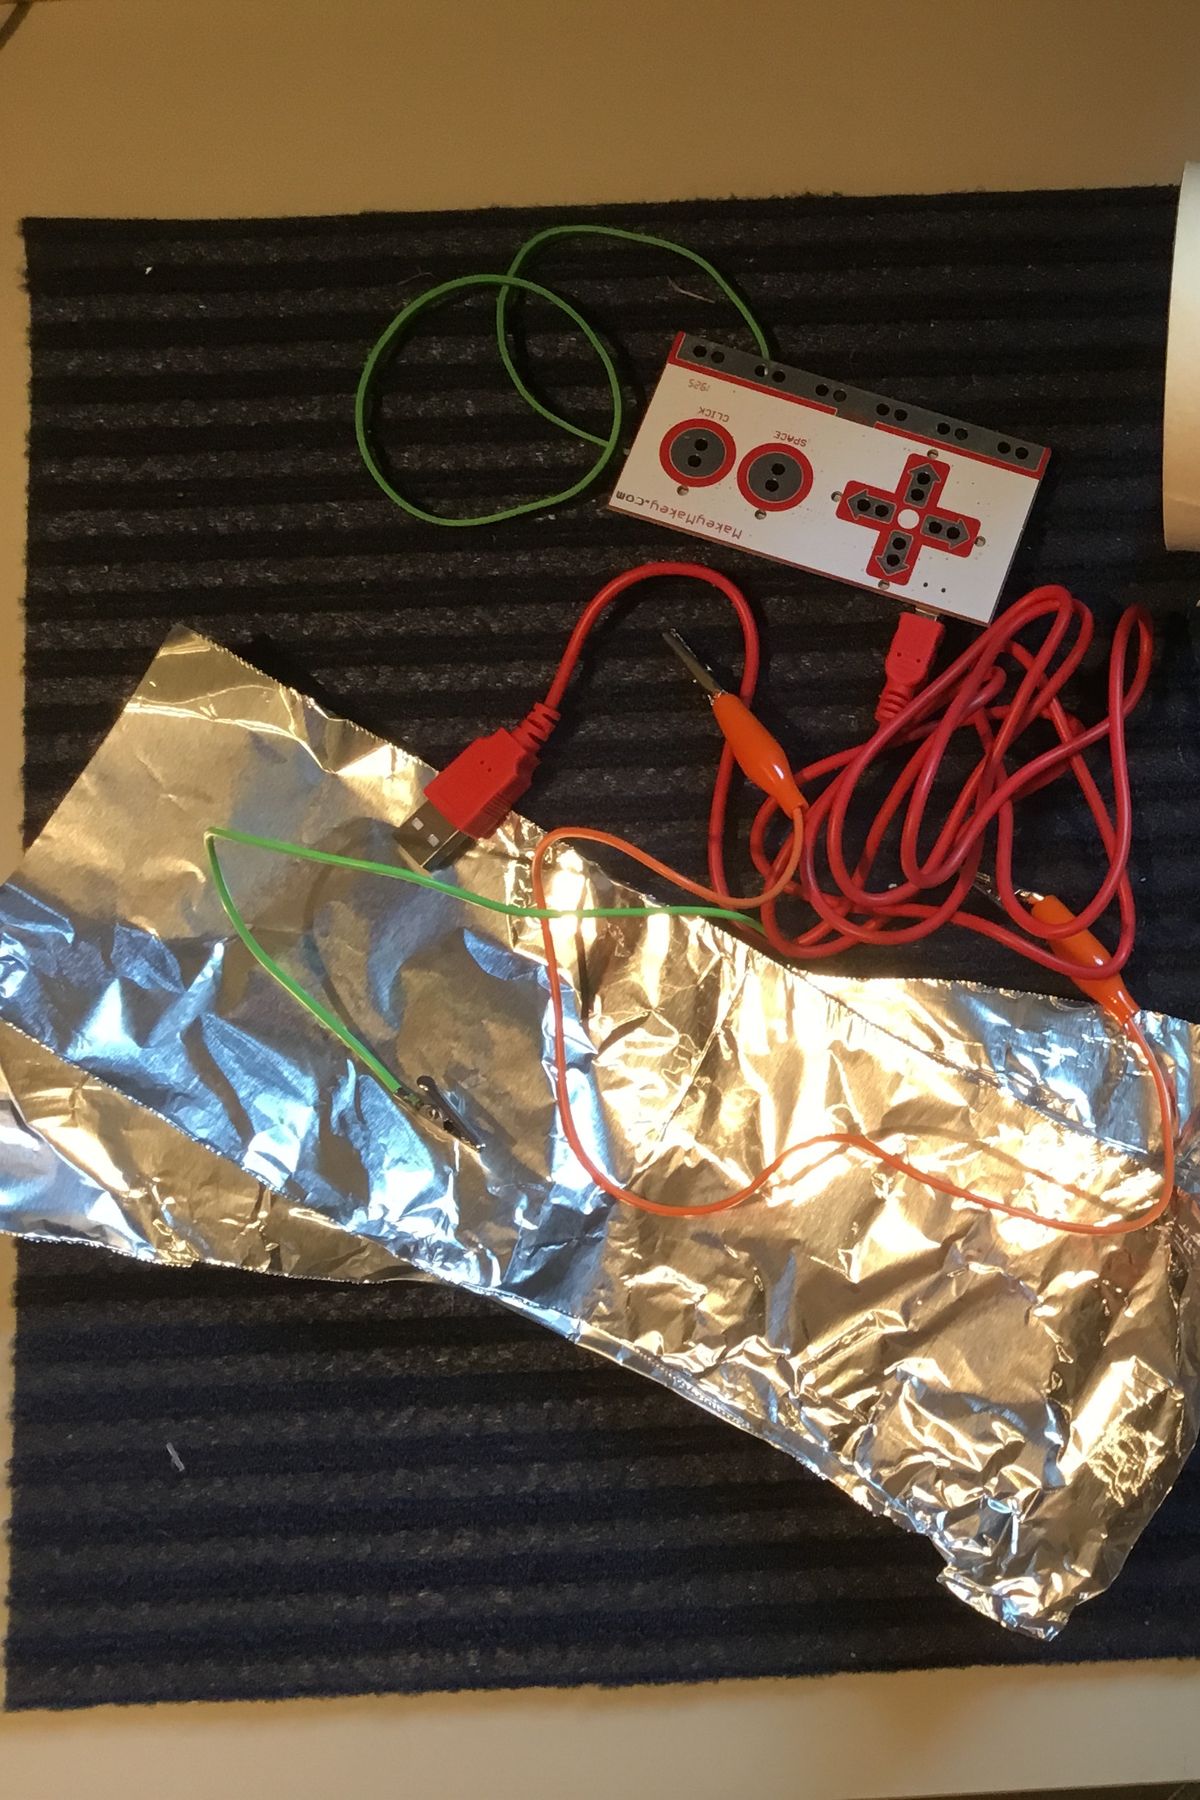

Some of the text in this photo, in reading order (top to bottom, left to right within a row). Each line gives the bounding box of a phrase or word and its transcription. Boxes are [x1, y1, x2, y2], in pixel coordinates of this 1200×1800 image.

[698, 406, 730, 422] CLICK
[774, 430, 807, 447] SPACE
[615, 491, 743, 540] MakeyMakey.com
